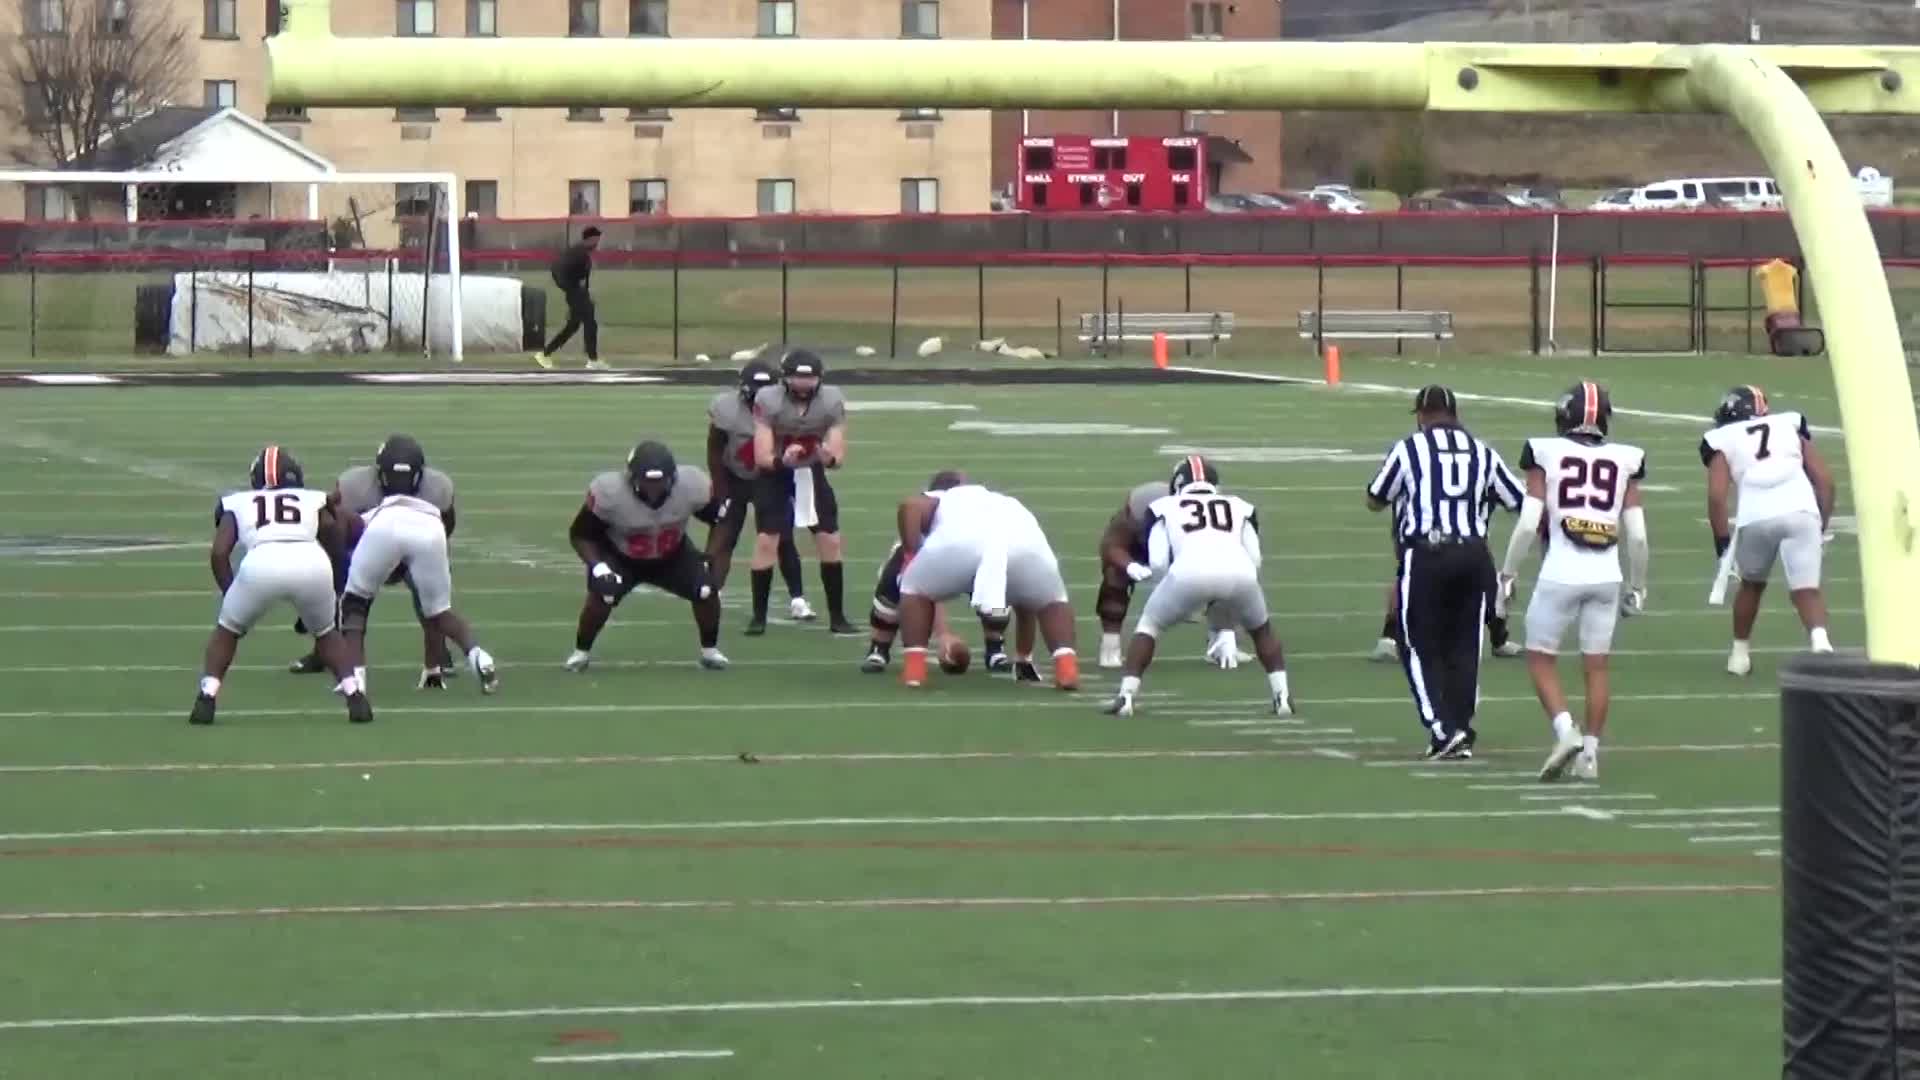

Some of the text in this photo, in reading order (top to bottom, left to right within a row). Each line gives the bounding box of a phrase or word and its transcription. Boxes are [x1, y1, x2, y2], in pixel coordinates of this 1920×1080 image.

[1025, 174, 1053, 183] BALL
[1067, 174, 1105, 183] STRIKE
[1122, 174, 1145, 183] OUT
[1746, 422, 1771, 461] 7
[1437, 452, 1471, 497] U
[1557, 455, 1619, 512] 29
[252, 493, 302, 529] 16
[1179, 498, 1234, 534] 30
